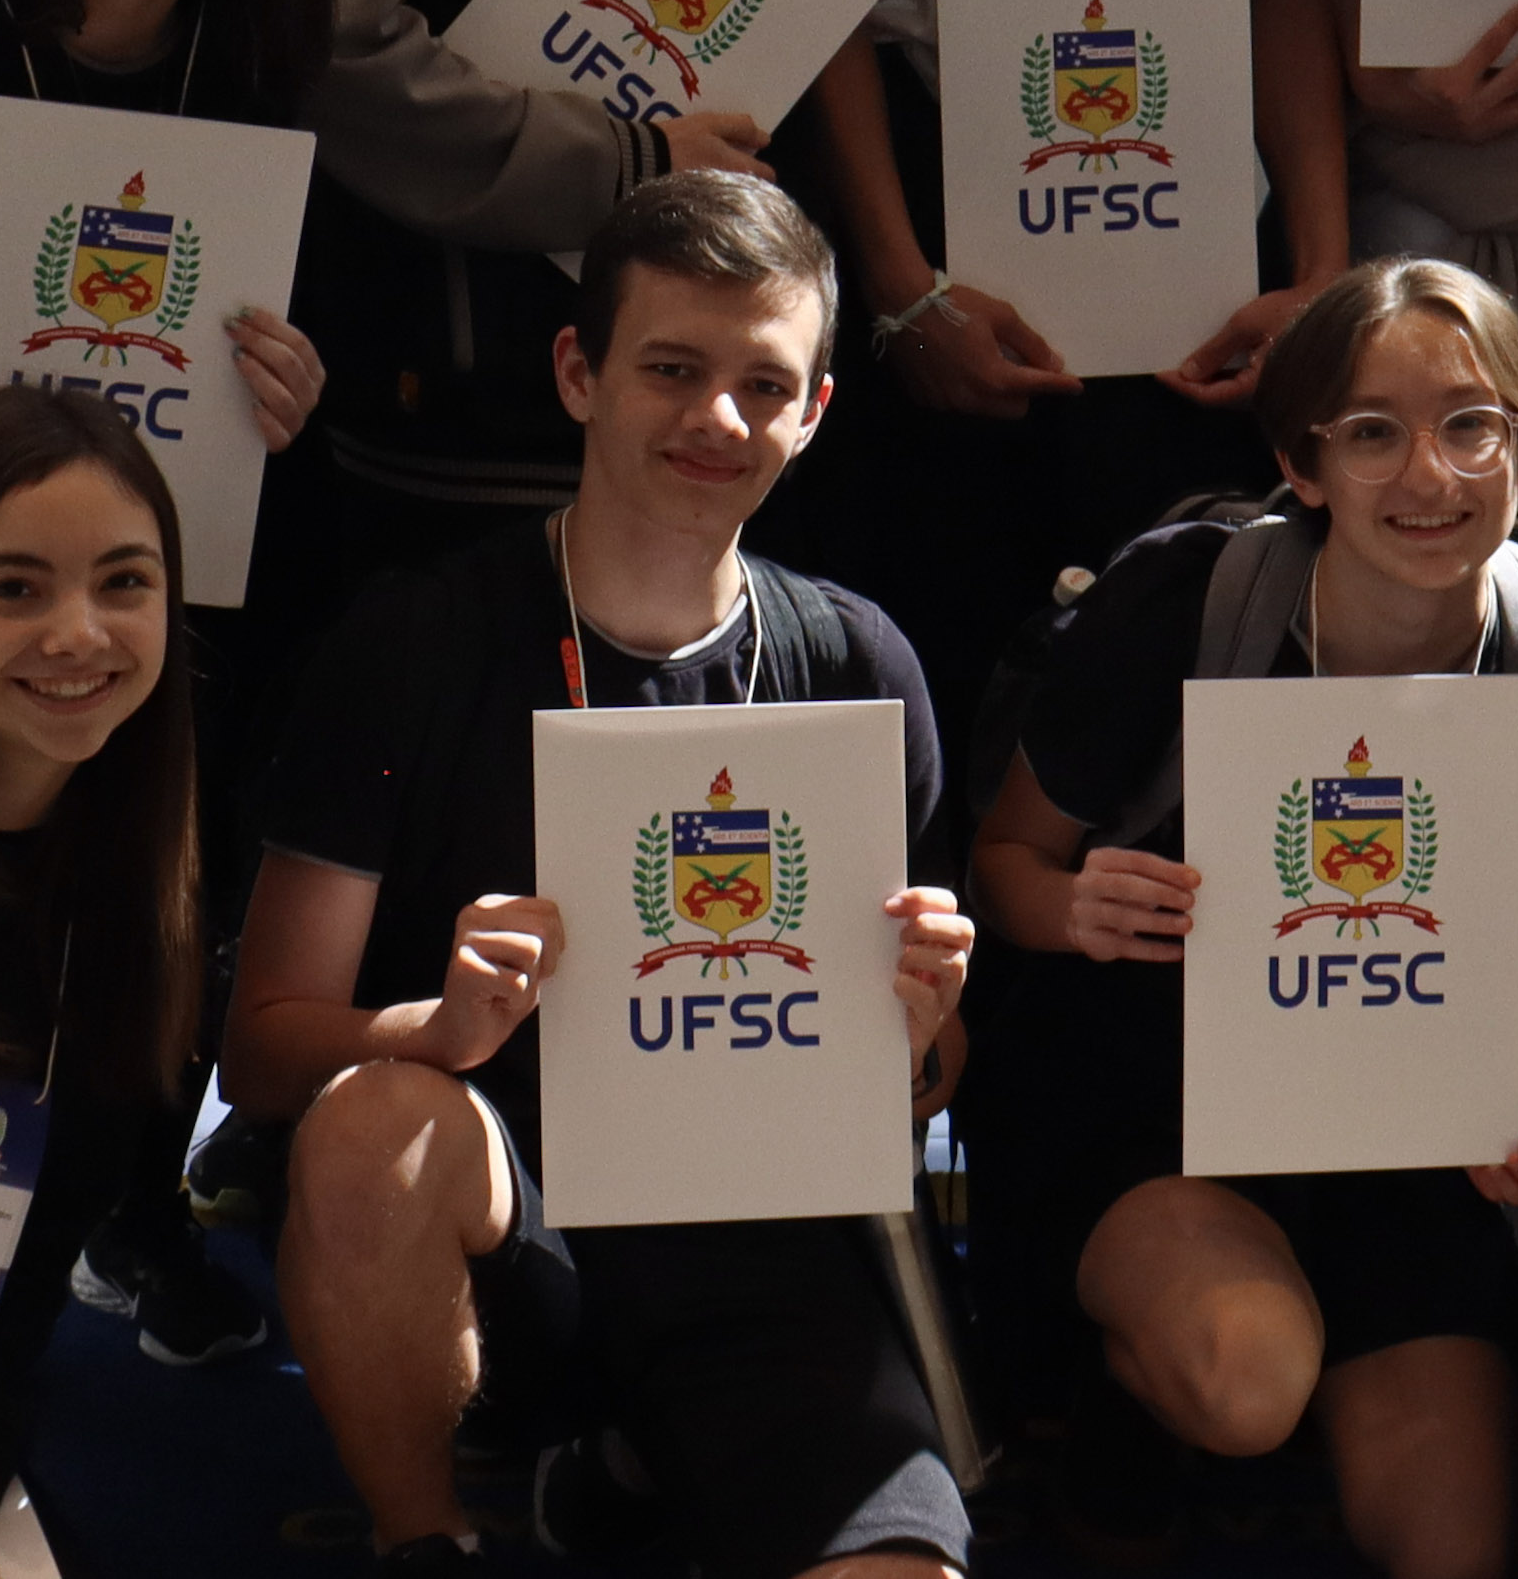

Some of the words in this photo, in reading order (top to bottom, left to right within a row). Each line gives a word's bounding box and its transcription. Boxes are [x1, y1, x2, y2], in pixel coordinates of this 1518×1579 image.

[1017, 181, 1180, 235] UFSC
[1268, 951, 1446, 1009] UFSC
[628, 990, 820, 1052] UFSC
